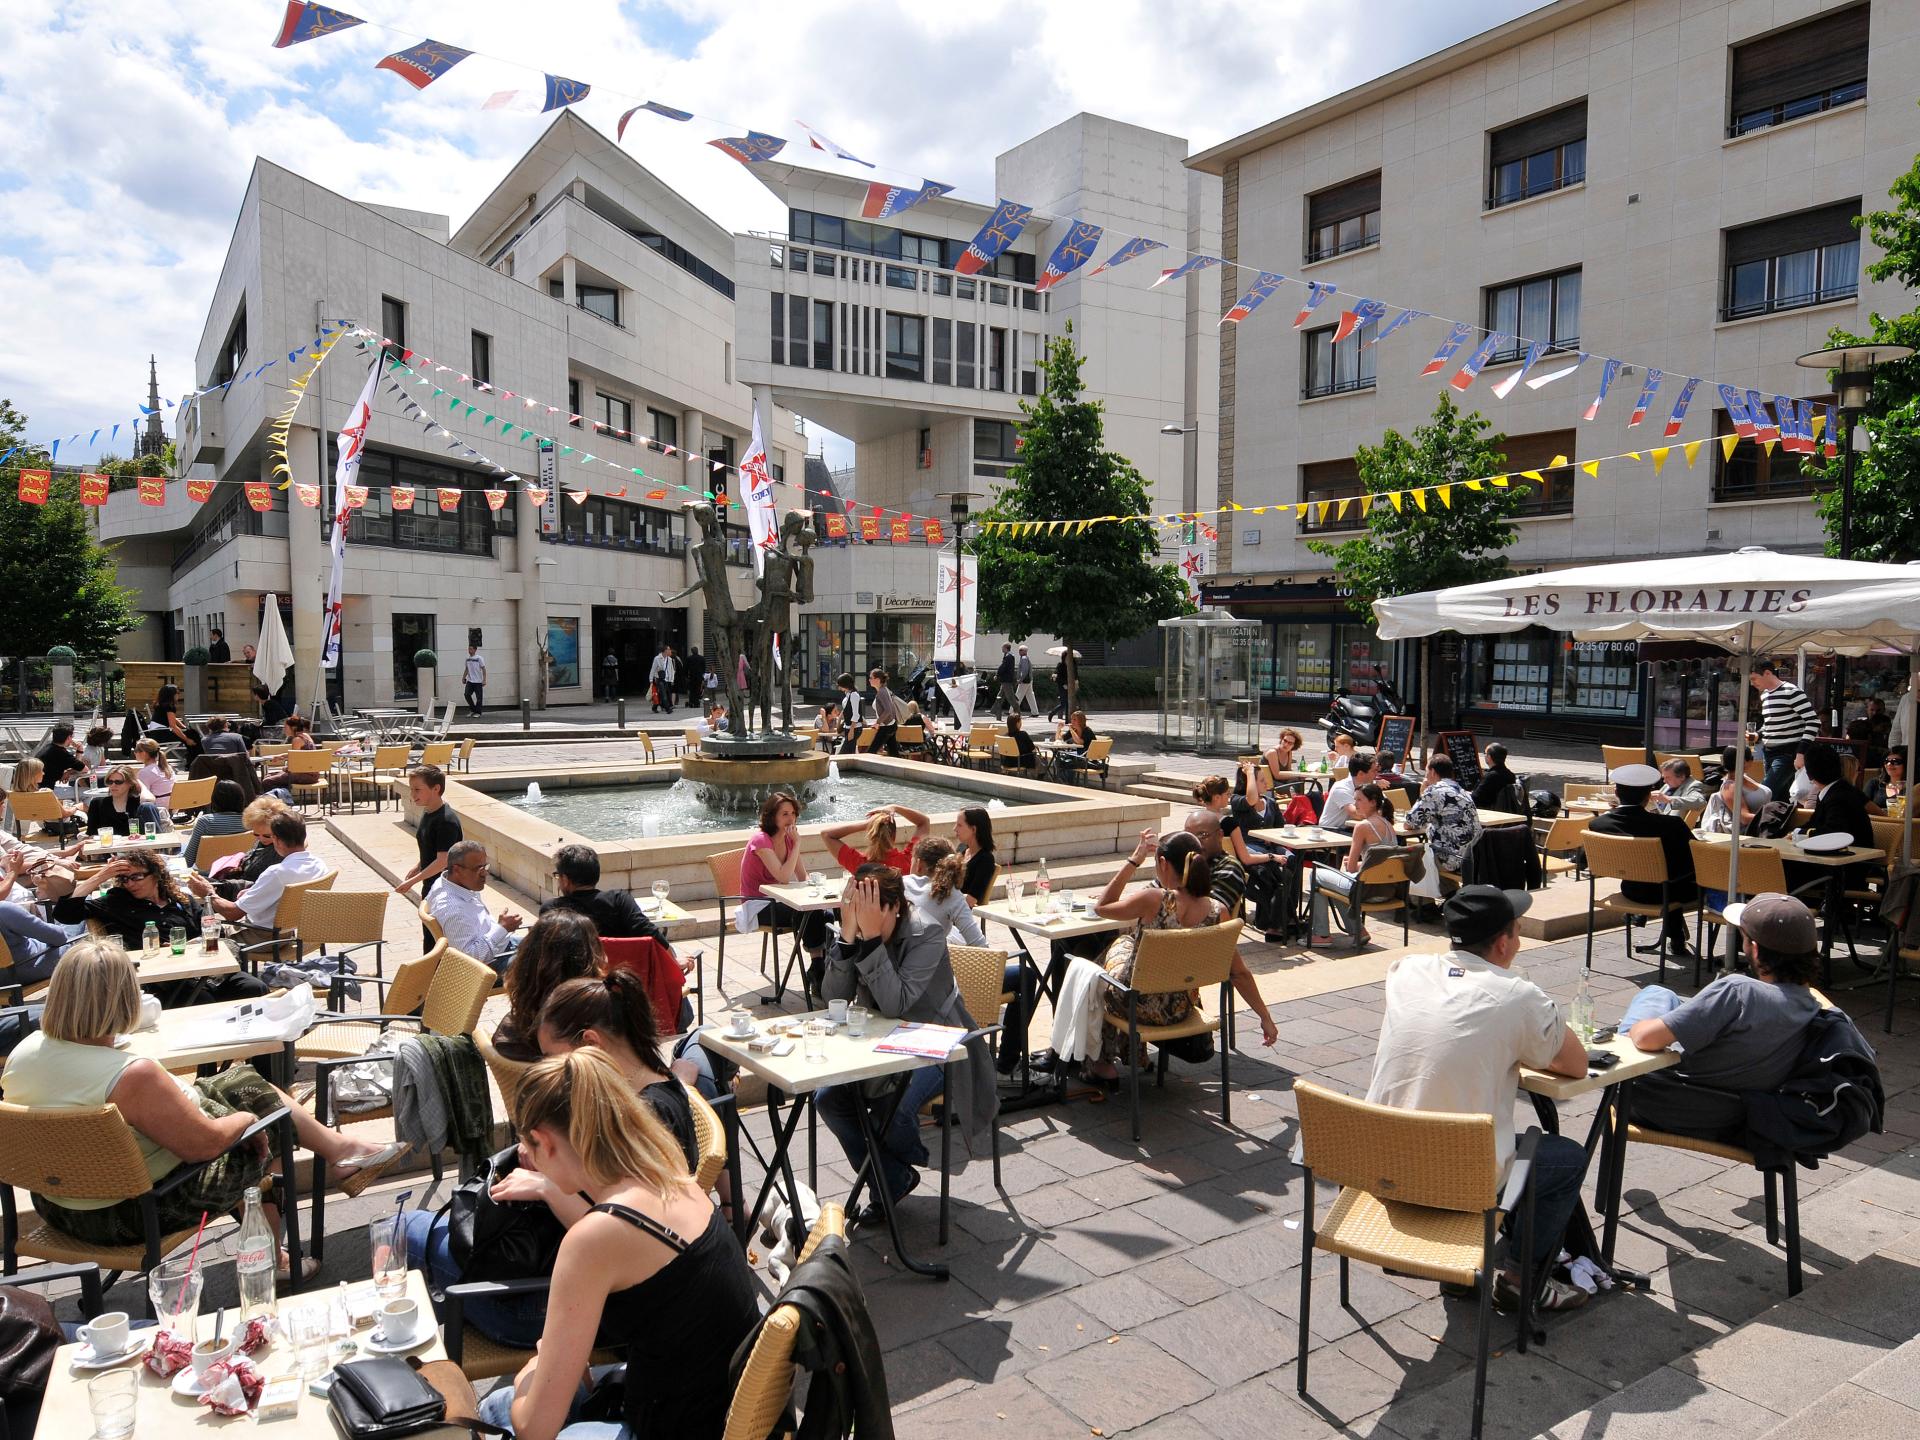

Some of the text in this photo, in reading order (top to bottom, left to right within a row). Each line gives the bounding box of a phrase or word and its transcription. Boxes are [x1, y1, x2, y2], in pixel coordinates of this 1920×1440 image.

[391, 54, 436, 80] Rouen
[878, 187, 901, 219] Rouen
[1503, 589, 1811, 617] LES FLORALIES
[1574, 641, 1635, 652] 02 35 07 80 60
